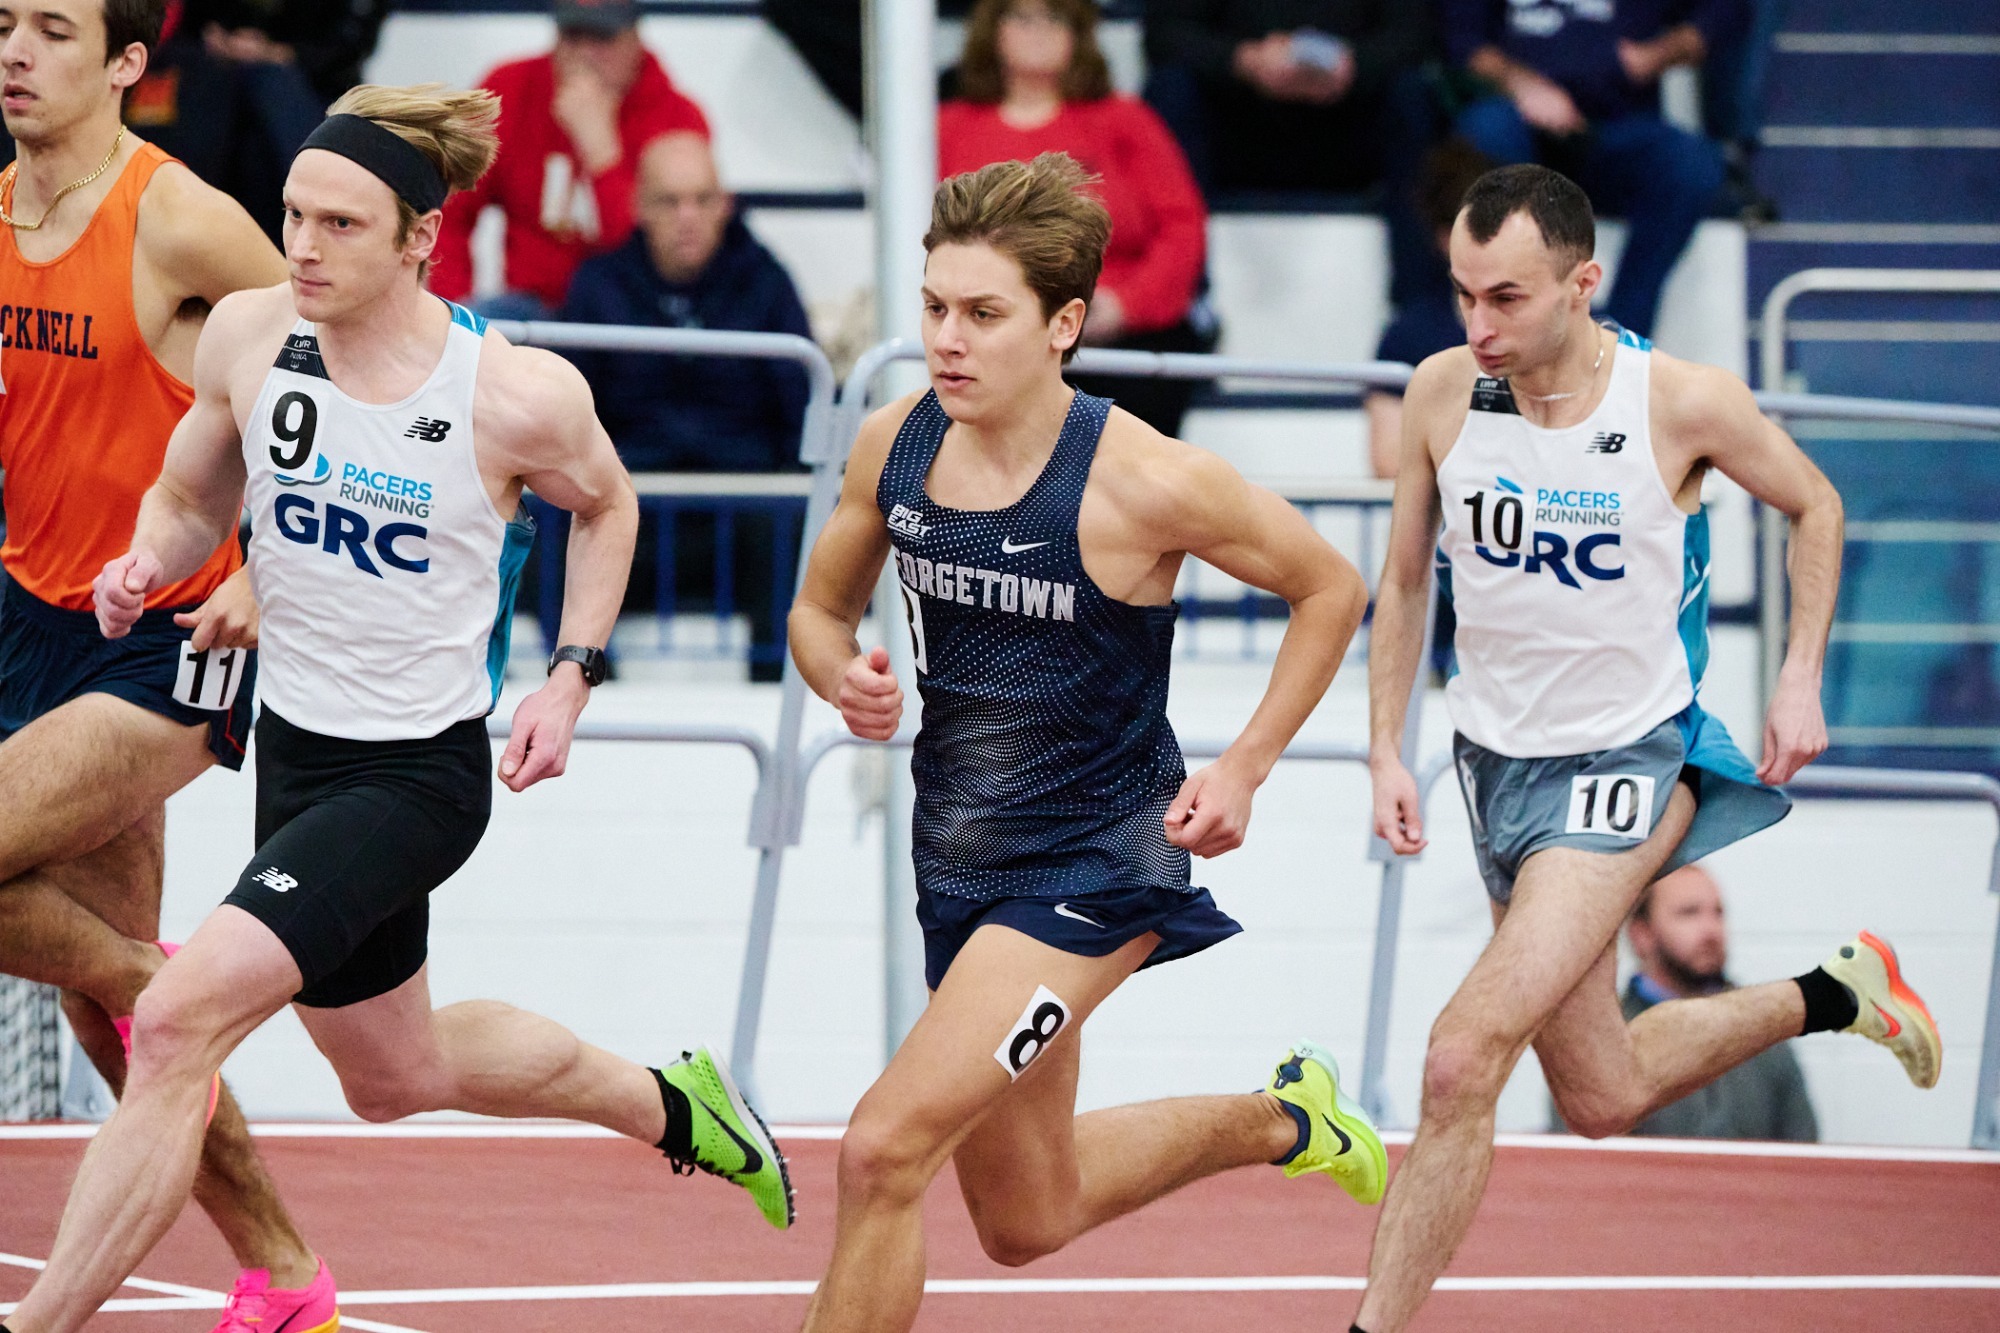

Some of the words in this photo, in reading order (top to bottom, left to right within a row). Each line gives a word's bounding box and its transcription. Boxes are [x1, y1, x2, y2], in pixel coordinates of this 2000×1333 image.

[0, 305, 98, 359] CKNELL
[269, 391, 318, 470] 9
[339, 483, 430, 519] RUNNING
[342, 463, 433, 501] PACERS
[1537, 489, 1621, 510] PACERS
[274, 493, 431, 580] GRC
[888, 513, 933, 538] EAST
[891, 504, 924, 523] BIG
[1463, 491, 1524, 551] 10
[1535, 508, 1621, 526] RUNNING
[186, 648, 237, 708] 11
[1578, 778, 1640, 833] 10
[1008, 1001, 1065, 1075] 8
